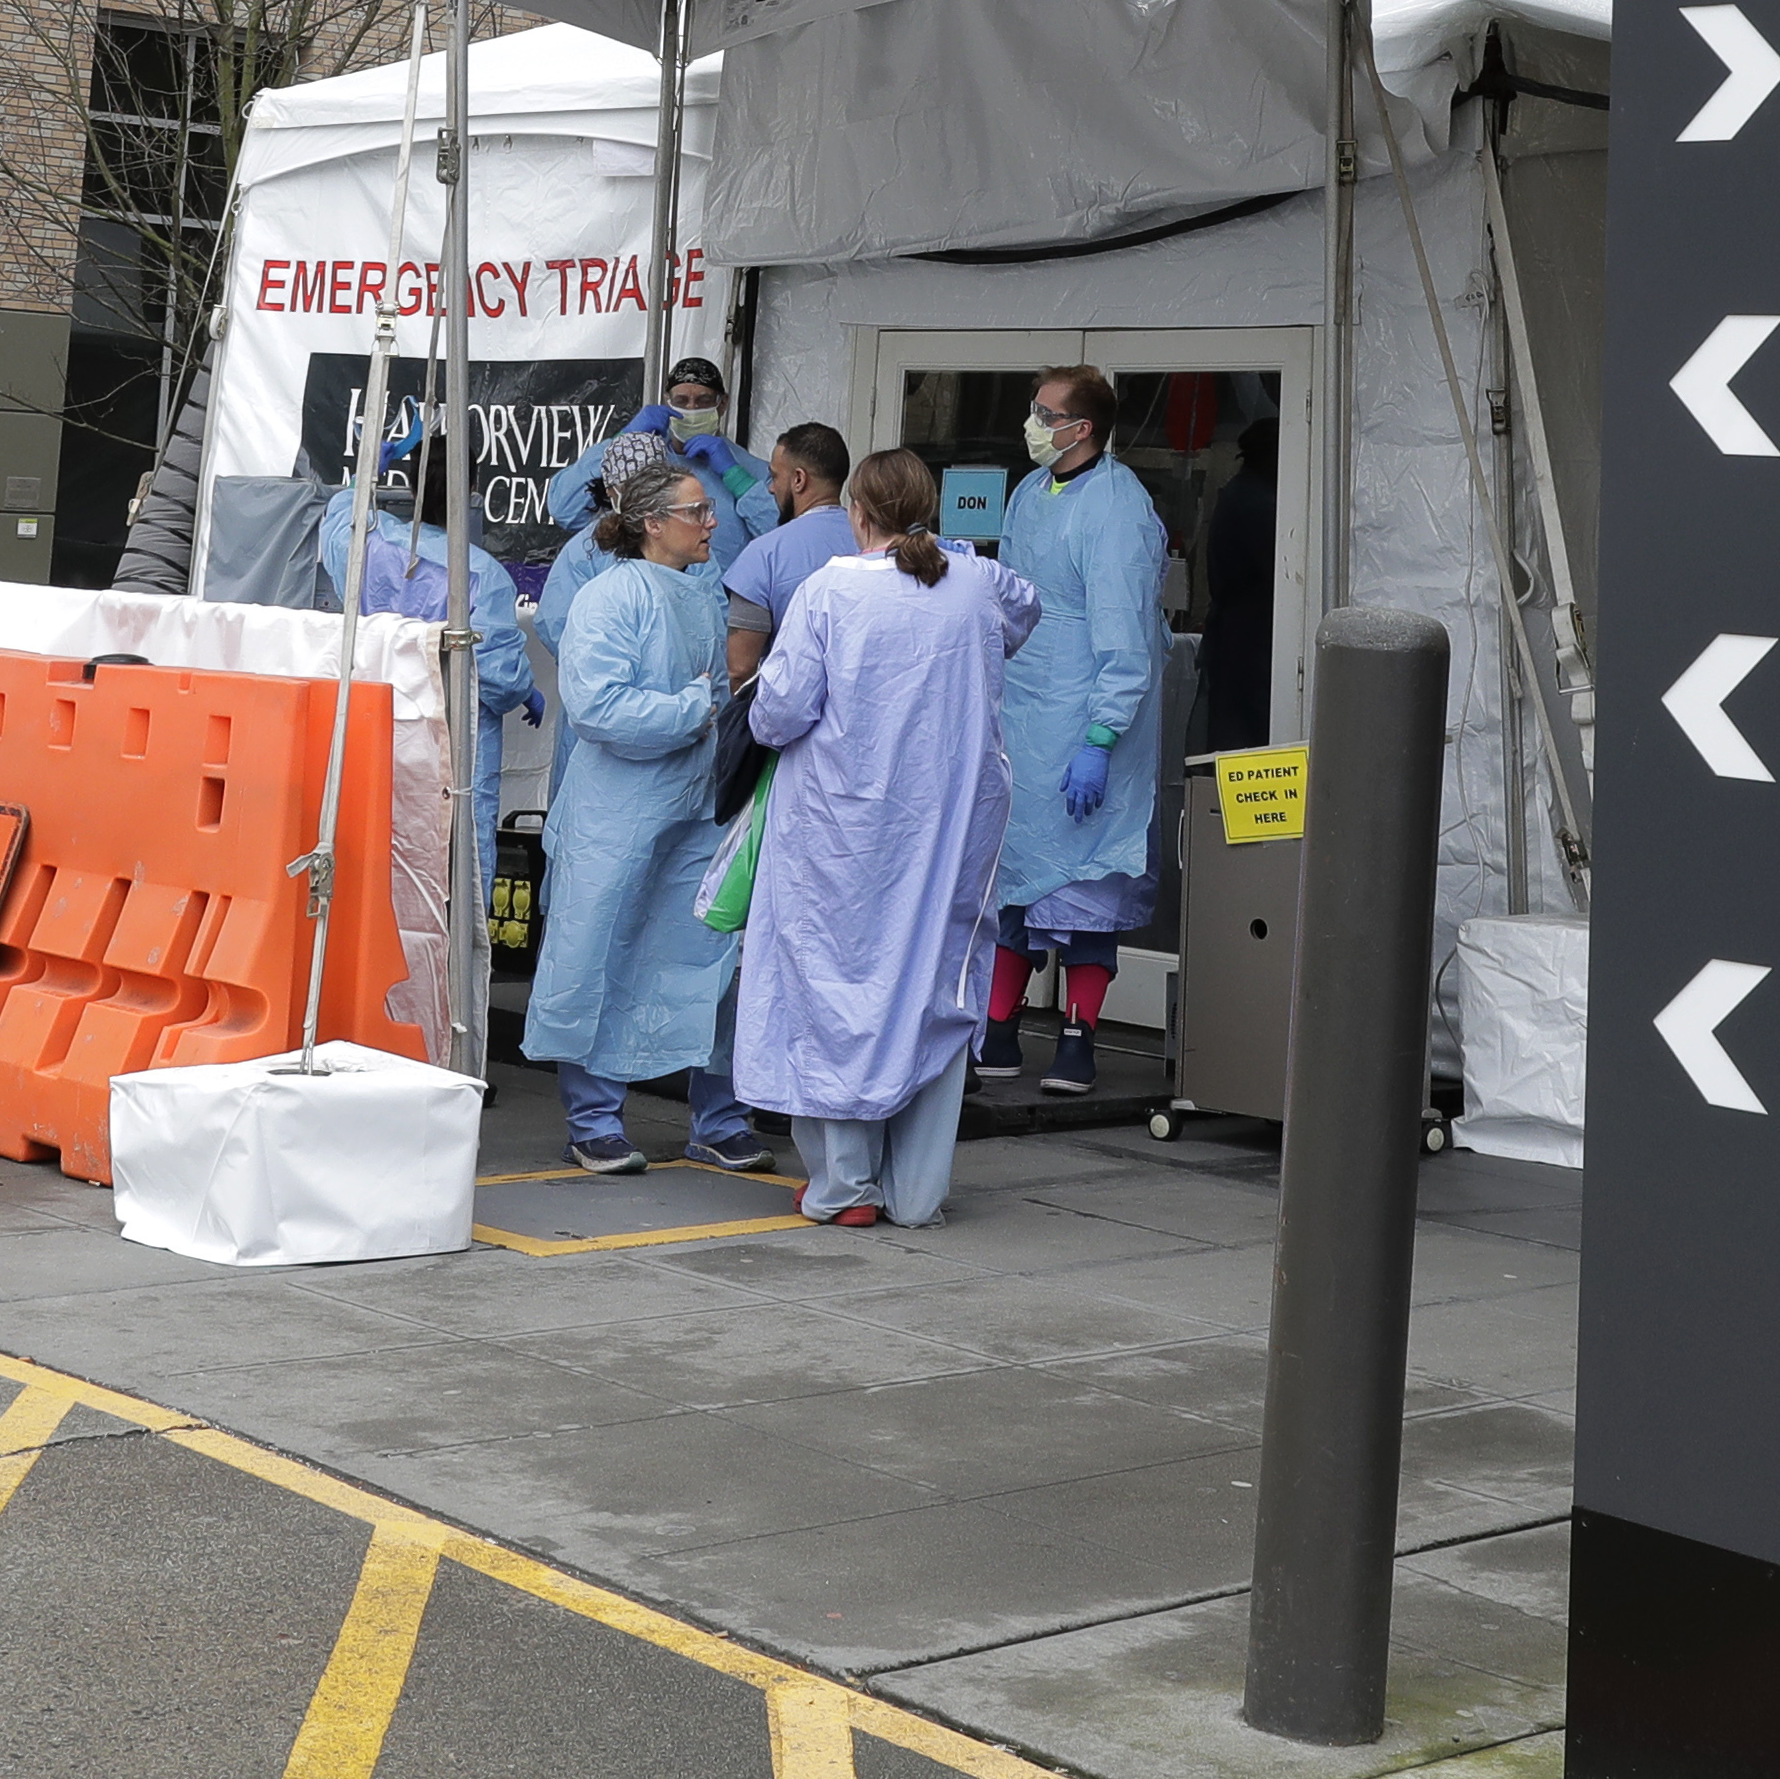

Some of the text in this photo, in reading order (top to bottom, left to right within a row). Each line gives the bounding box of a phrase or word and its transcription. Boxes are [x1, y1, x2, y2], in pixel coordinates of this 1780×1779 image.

[256, 259, 532, 317] EMERGECY
[957, 496, 987, 510] DON
[1228, 766, 1299, 782] ED PATIENT
[1236, 788, 1297, 803] CHECK IN
[1254, 812, 1287, 824] HERE
